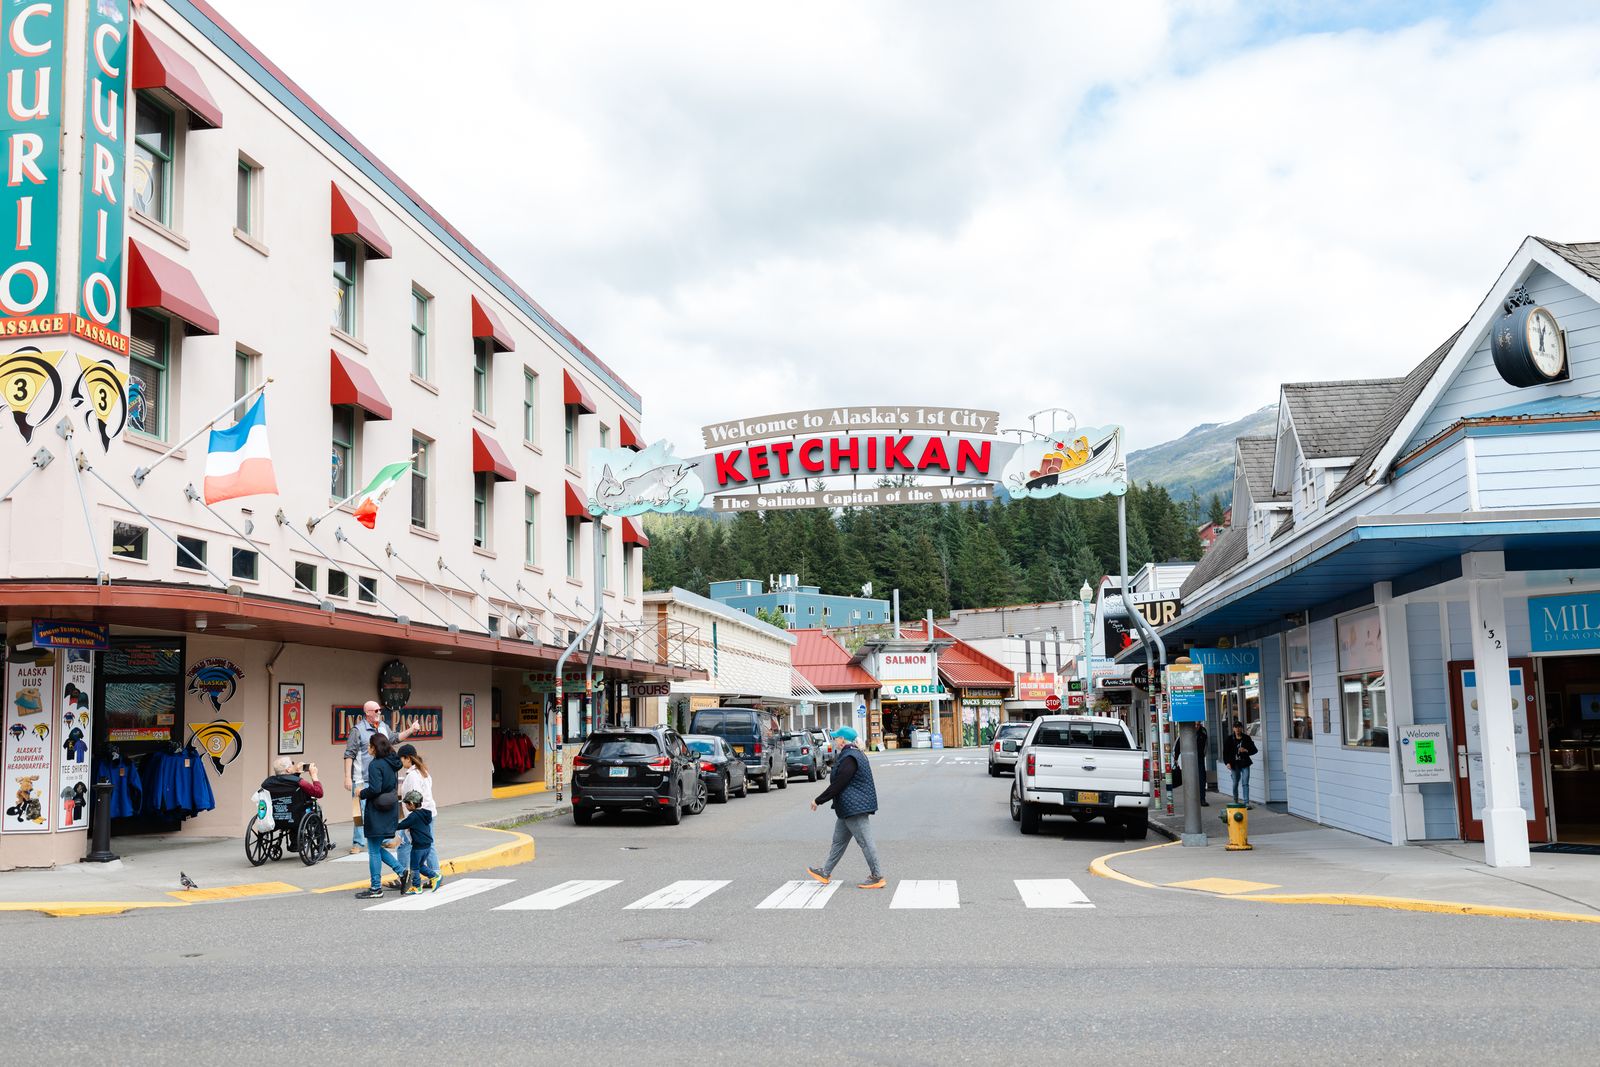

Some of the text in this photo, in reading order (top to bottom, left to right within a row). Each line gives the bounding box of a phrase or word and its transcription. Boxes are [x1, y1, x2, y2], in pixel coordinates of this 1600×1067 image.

[0, 3, 52, 314] CURIO
[84, 23, 121, 325] CURIO
[75, 317, 126, 351] PASSAGE
[13, 378, 28, 401] 3
[98, 388, 108, 412] 3
[710, 407, 990, 442] Welcome to Alaska's 1st City
[714, 435, 992, 485] KETCHIKAN
[720, 486, 988, 509] The Salmon Capital of the World
[1133, 590, 1176, 602] SITKA
[1134, 600, 1177, 626] FUR
[1543, 604, 1600, 633] MIL
[885, 655, 926, 664] SALMON
[1195, 652, 1255, 665] MILANO
[18, 667, 47, 677] ALASKA
[66, 664, 91, 673] BASEBALL
[22, 678, 42, 687] ULUS
[72, 675, 85, 684] HATS
[630, 684, 669, 696] TOURS
[894, 684, 944, 694] GARDEN
[1046, 699, 1060, 707] STOP
[1406, 729, 1440, 738] Welcome
[212, 737, 221, 751] 3
[62, 765, 88, 774] TEE SHIRTS
